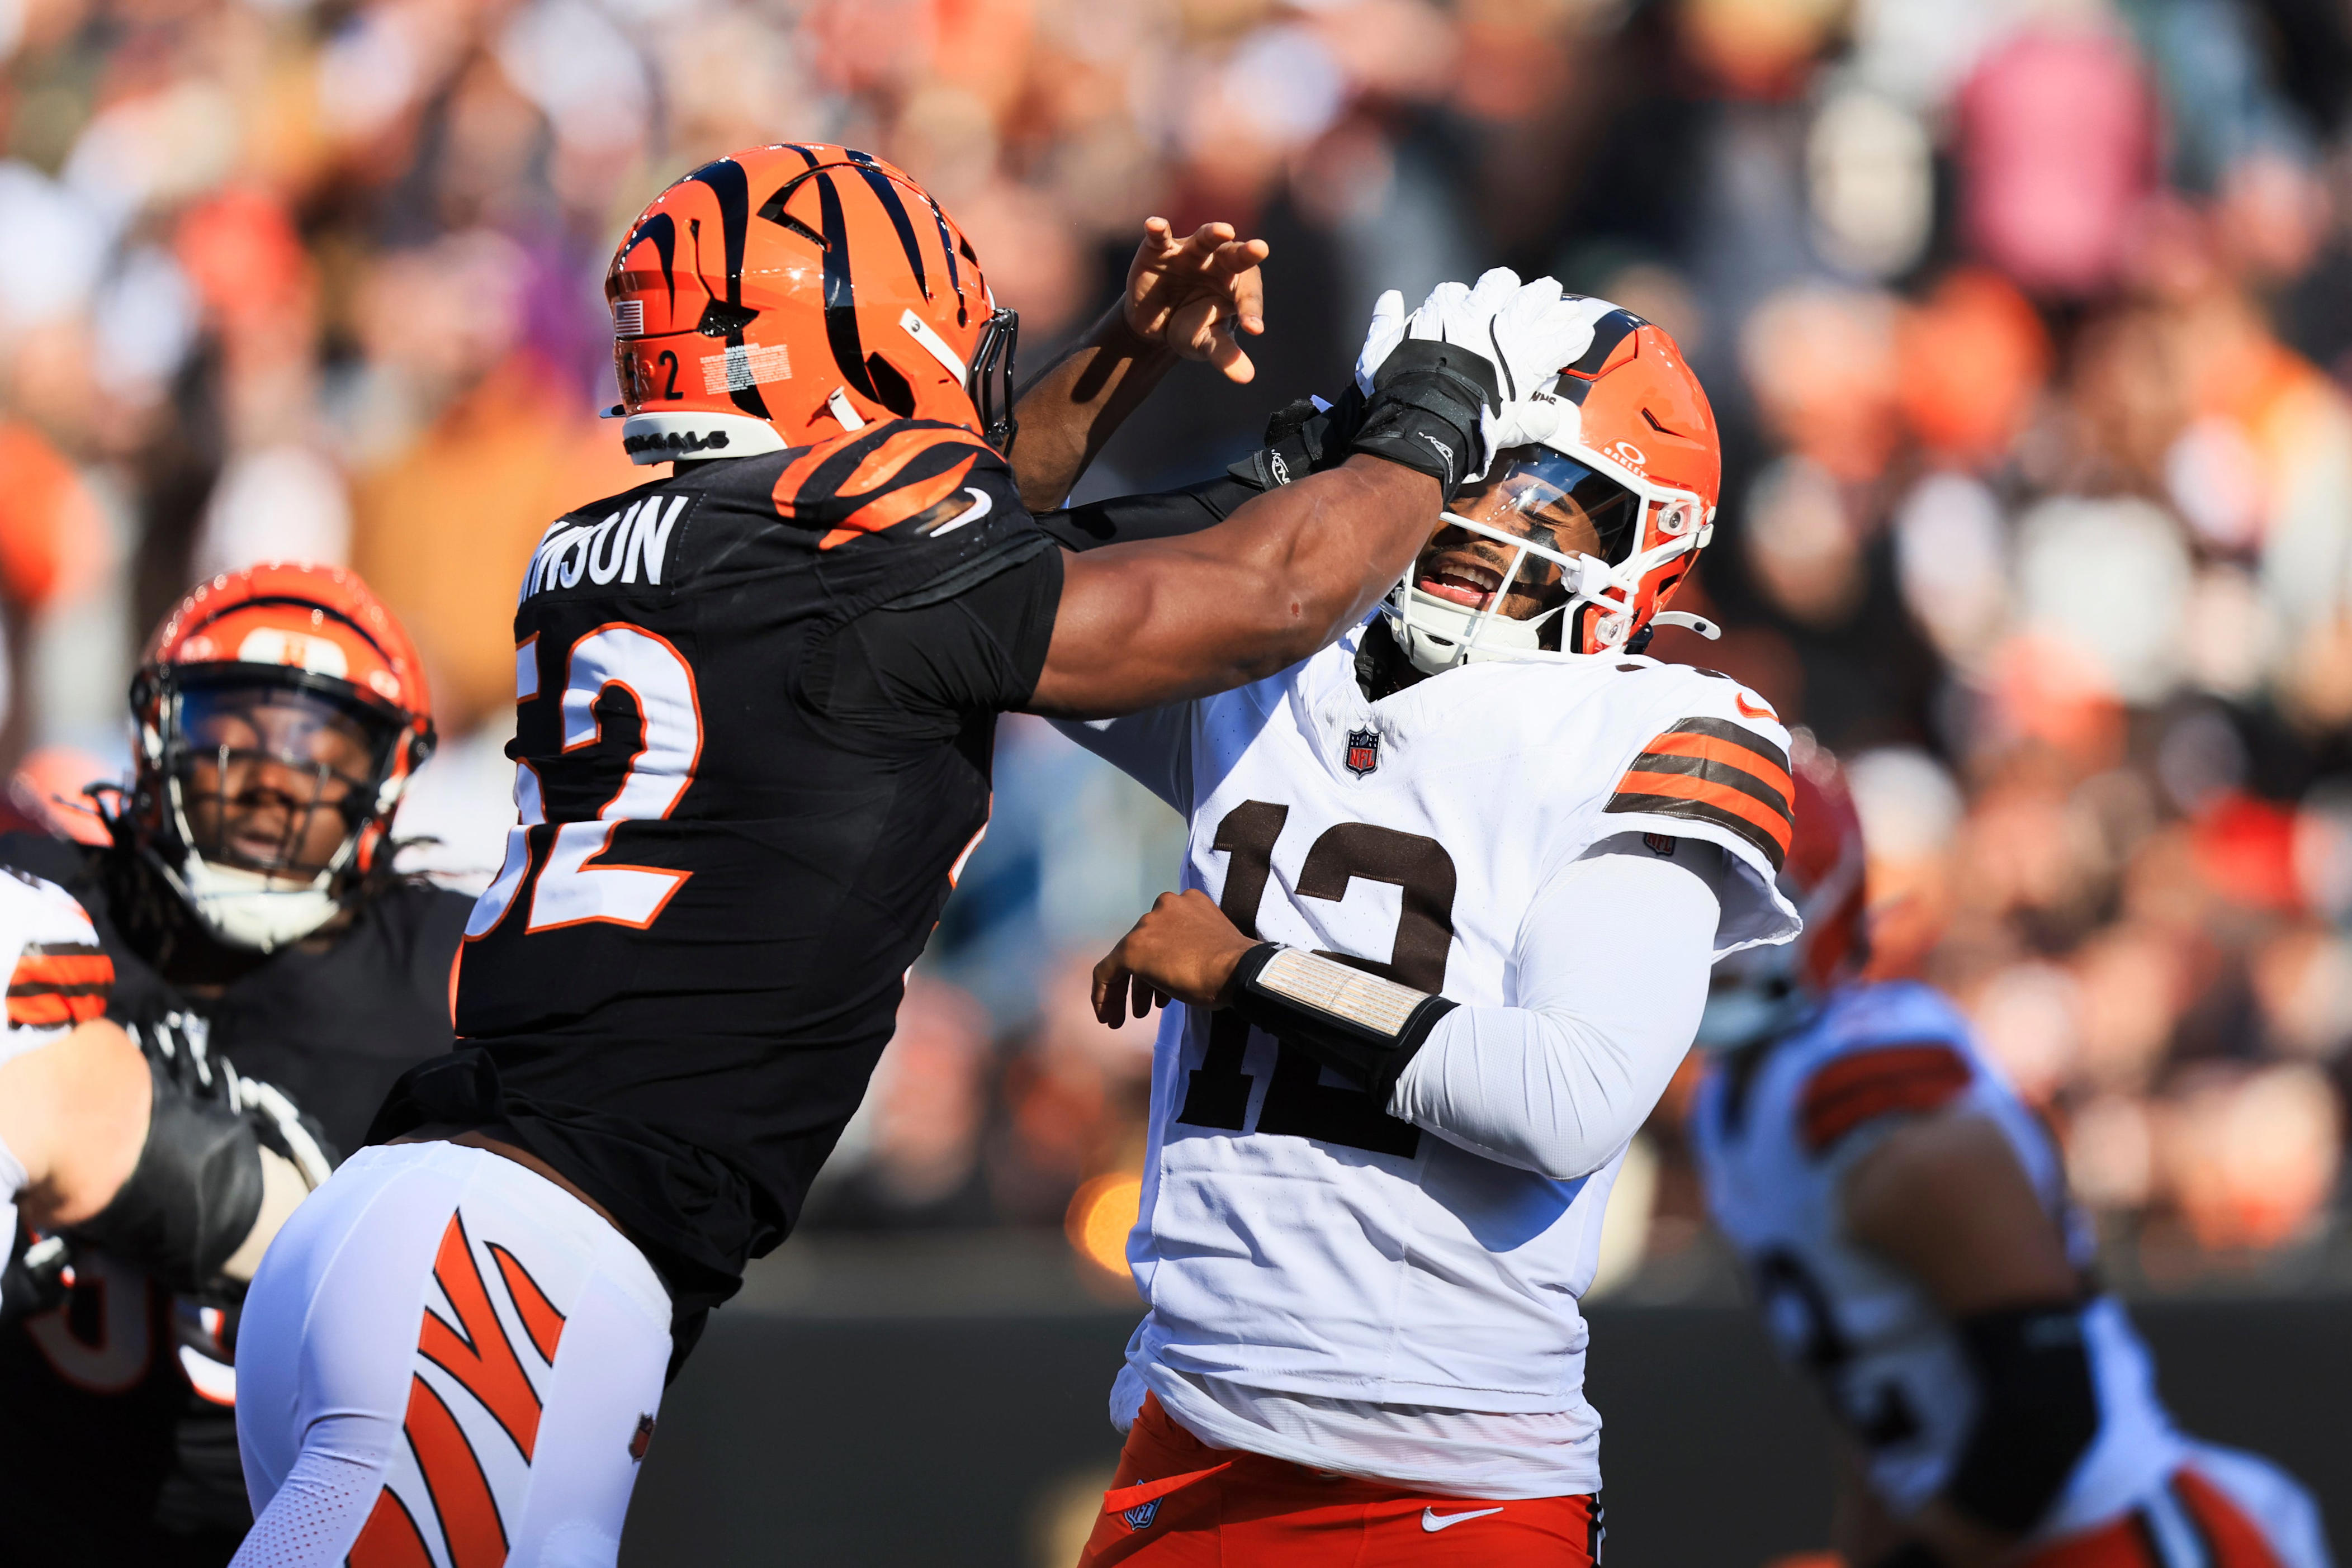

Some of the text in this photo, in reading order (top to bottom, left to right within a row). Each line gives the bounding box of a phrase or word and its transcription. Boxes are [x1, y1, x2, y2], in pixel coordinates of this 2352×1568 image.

[1603, 447, 1649, 477] OAKLEY
[1349, 748, 1375, 770] NFL
[1176, 799, 1457, 1159] 12
